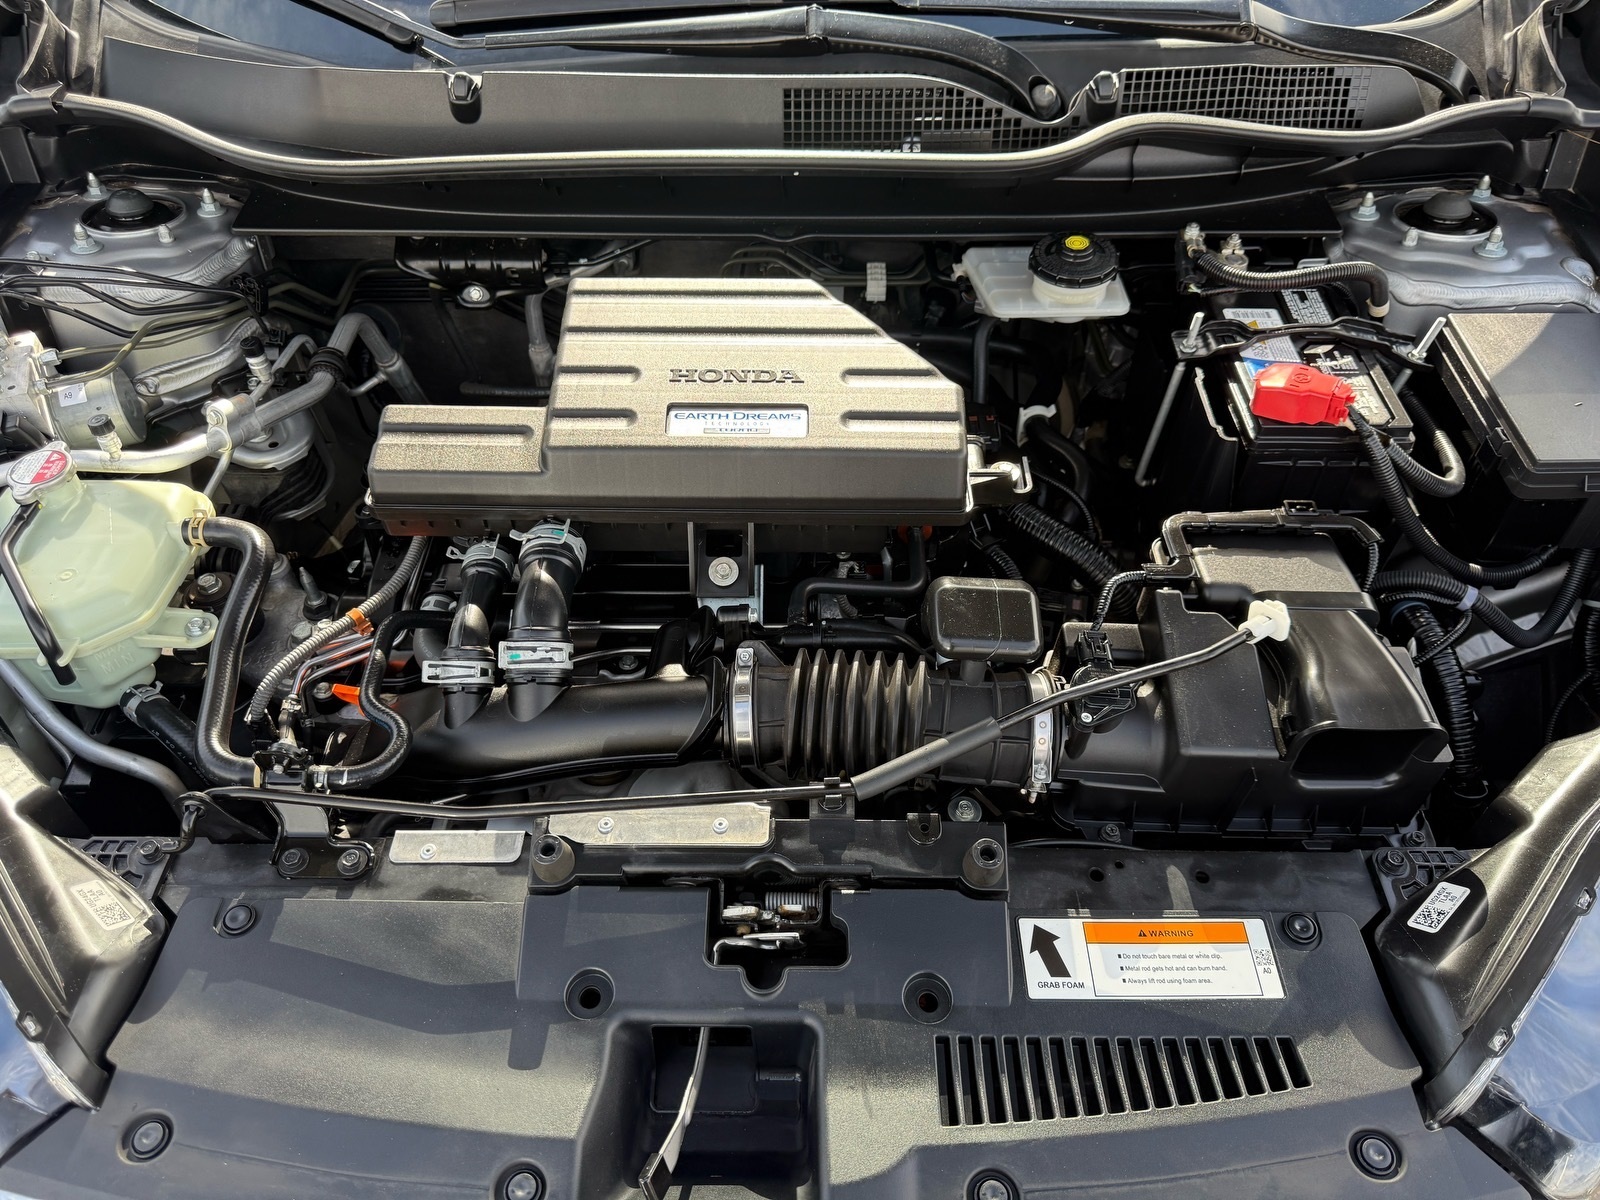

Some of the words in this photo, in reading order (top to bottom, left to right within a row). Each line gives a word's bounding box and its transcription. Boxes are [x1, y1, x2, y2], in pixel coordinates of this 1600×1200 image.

[669, 368, 805, 383] HONDA
[674, 412, 729, 420] EARTH
[733, 412, 801, 420] DREAMS
[1037, 981, 1060, 989] GRAB
[1061, 981, 1085, 989] FOAM
